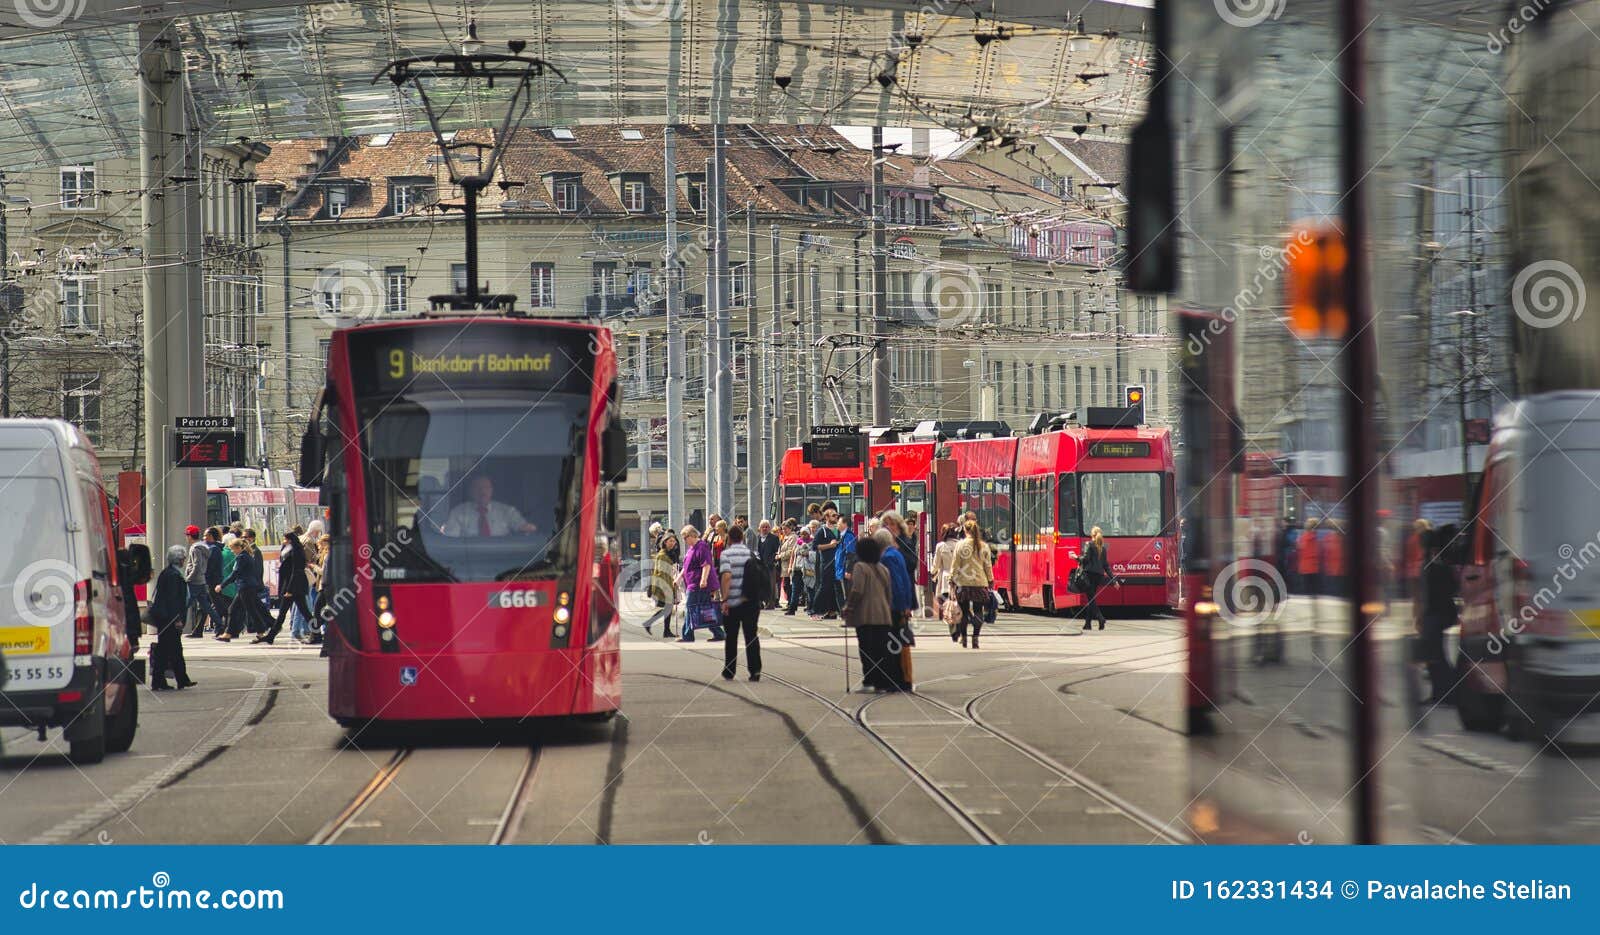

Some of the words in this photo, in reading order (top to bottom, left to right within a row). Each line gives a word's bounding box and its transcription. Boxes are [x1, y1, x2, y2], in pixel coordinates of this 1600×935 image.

[389, 349, 404, 378] 9
[487, 353, 551, 372] Bahnhof
[182, 418, 218, 427] Perron
[222, 418, 229, 426] B
[816, 426, 845, 434] Perron
[848, 426, 854, 434] C
[1127, 563, 1160, 571] NEUTRAL
[500, 589, 537, 608] 666
[27, 668, 42, 680] 55
[47, 667, 63, 679] 55
